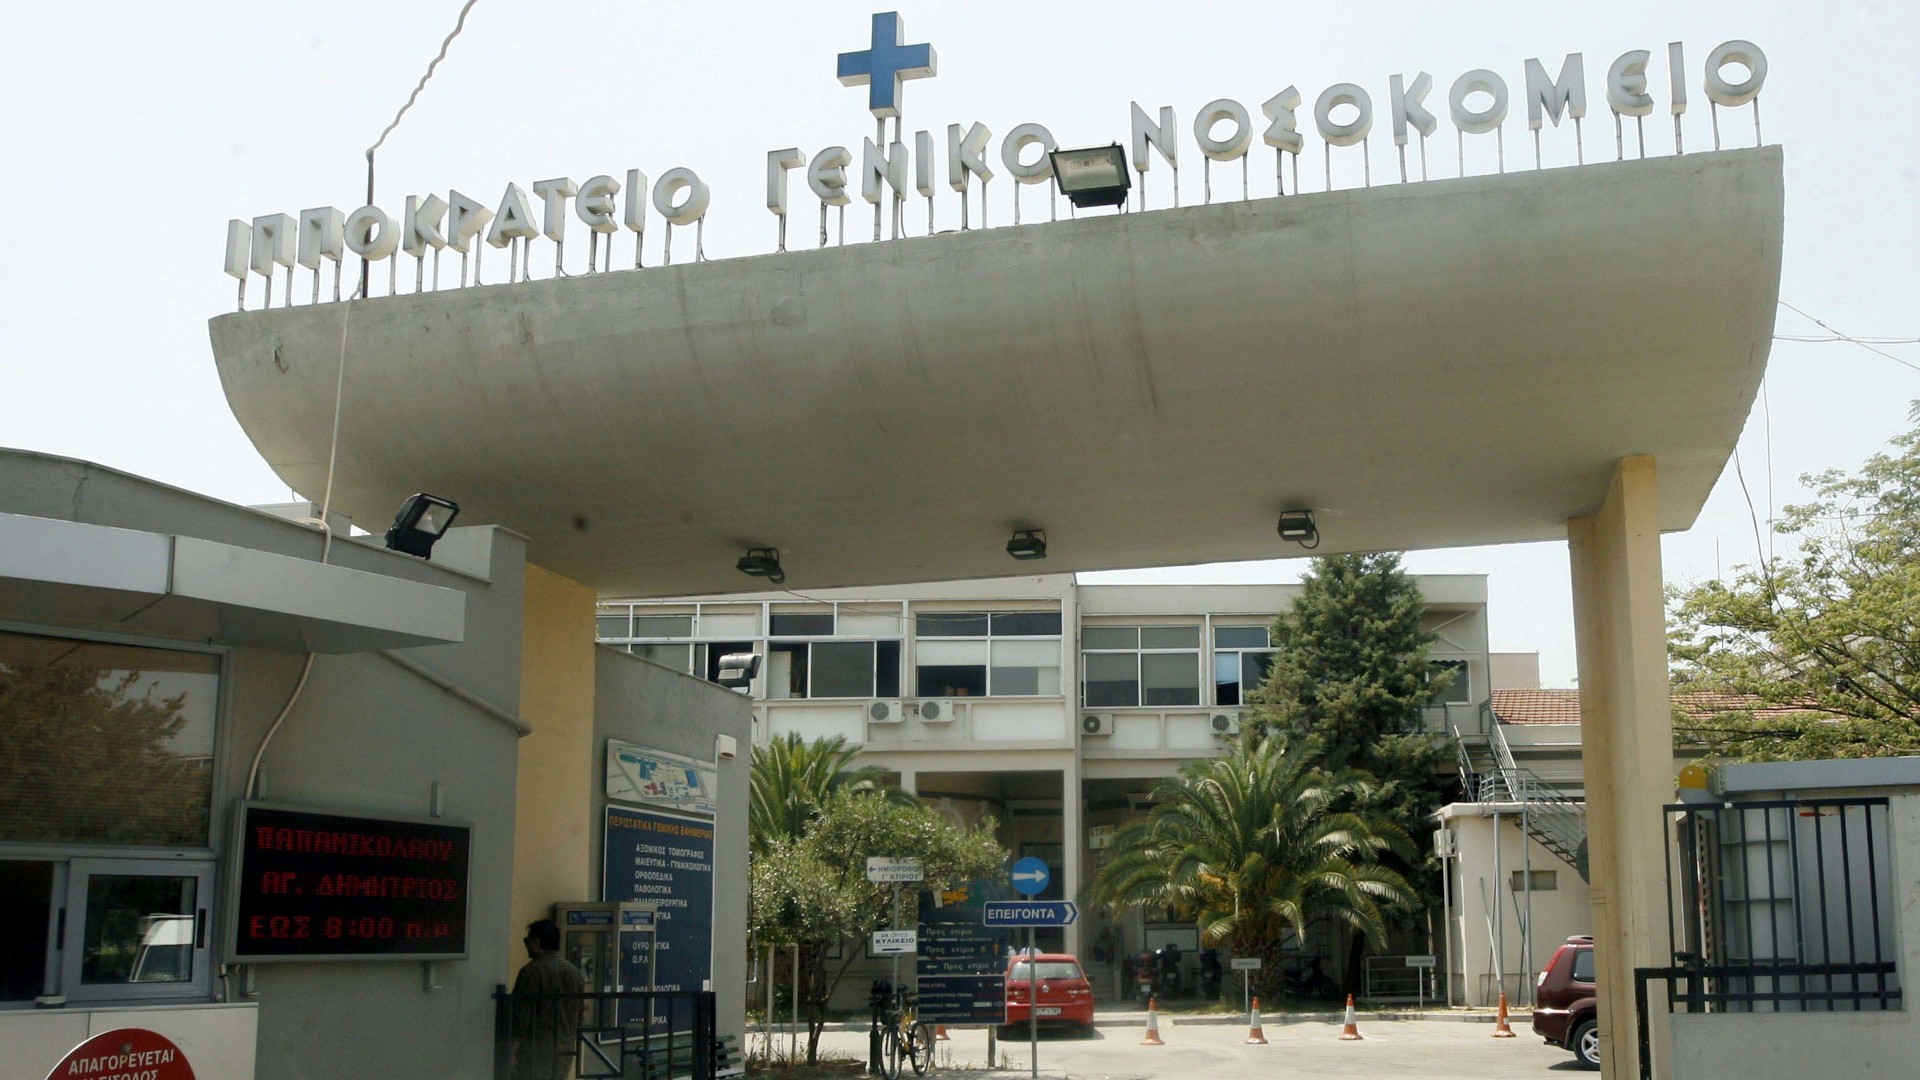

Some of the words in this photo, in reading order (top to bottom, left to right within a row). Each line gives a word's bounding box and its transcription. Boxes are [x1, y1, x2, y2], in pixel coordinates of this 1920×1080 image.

[224, 167, 710, 280] ΙΠΠΟΚΡΑΤΕΙΟ
[767, 121, 1057, 215] ΓΕΝΙΚΟ
[1131, 40, 1768, 172] ΝΟΣΟΚΟΜΕΙΟ
[256, 826, 455, 861] ΠΑΠΑΝΙΚΟΛΑΟΥ
[636, 843, 666, 855] ΑΞΟΝΙΚΟΣ
[668, 847, 704, 859] ΤΟΜΟΓΡΑΦΟΣ
[635, 857, 666, 868] ΜΑΙΕΥΤΙΚΑ
[670, 860, 711, 872] ΓΥΝΑΙΚΟΛΟΓΙΚΑ
[261, 871, 303, 895] ΑΓ.
[316, 873, 459, 899] ΔΗΜΗΤΡΙΟΣ
[635, 870, 673, 881] ΟΡΘΟΠΕΔΙΚΑ
[634, 884, 671, 894] ΠΑΘΟΛΟΓΙΚΑ
[987, 908, 1056, 920] ΕΠΕΙΓΟΝΤΑ
[250, 916, 310, 938] ΕΩΣ
[325, 917, 394, 938] 8:00
[68, 1048, 175, 1076] ΑΠΑΓΟΡΕΥΕΤΑΙ
